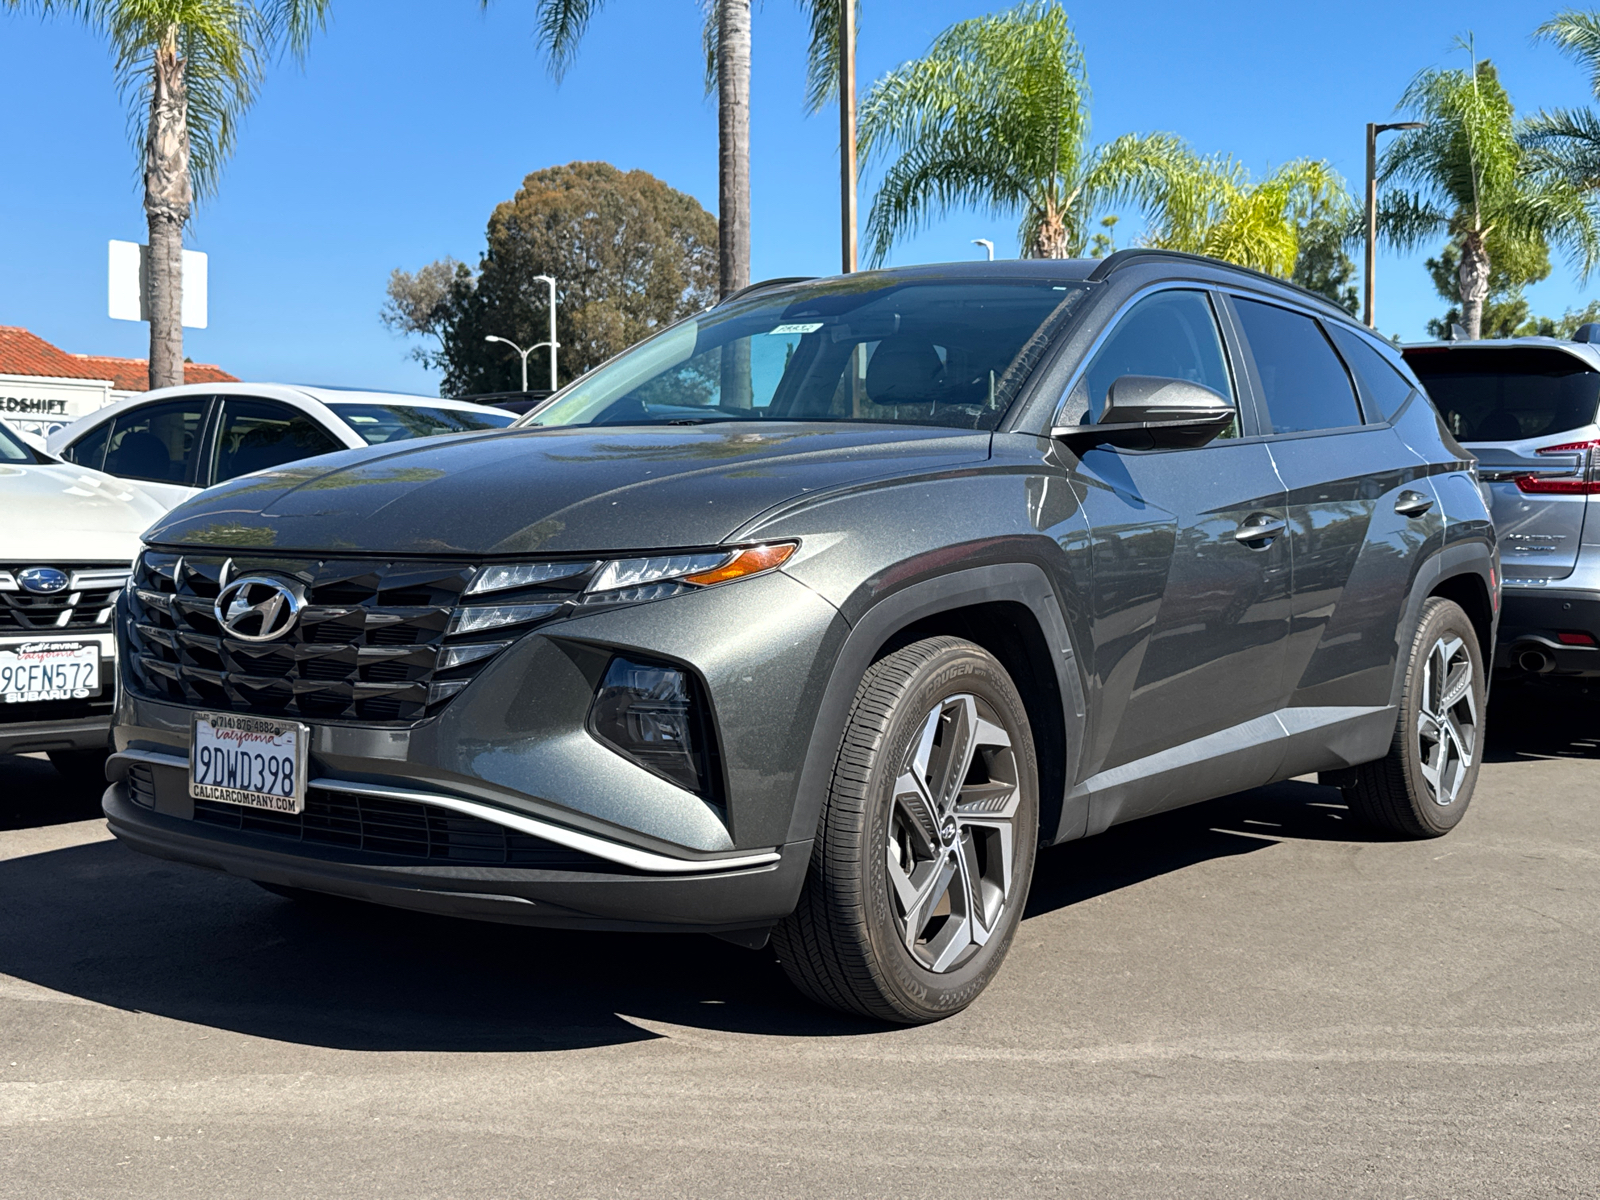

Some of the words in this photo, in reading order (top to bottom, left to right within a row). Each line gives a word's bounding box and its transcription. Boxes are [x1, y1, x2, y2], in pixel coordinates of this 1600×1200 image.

[1, 662, 94, 693] 9CFN572
[925, 663, 974, 699] CRUGEN
[5, 688, 71, 703] SUBARU
[216, 715, 236, 729] (714)
[200, 745, 294, 797] 9DWD398
